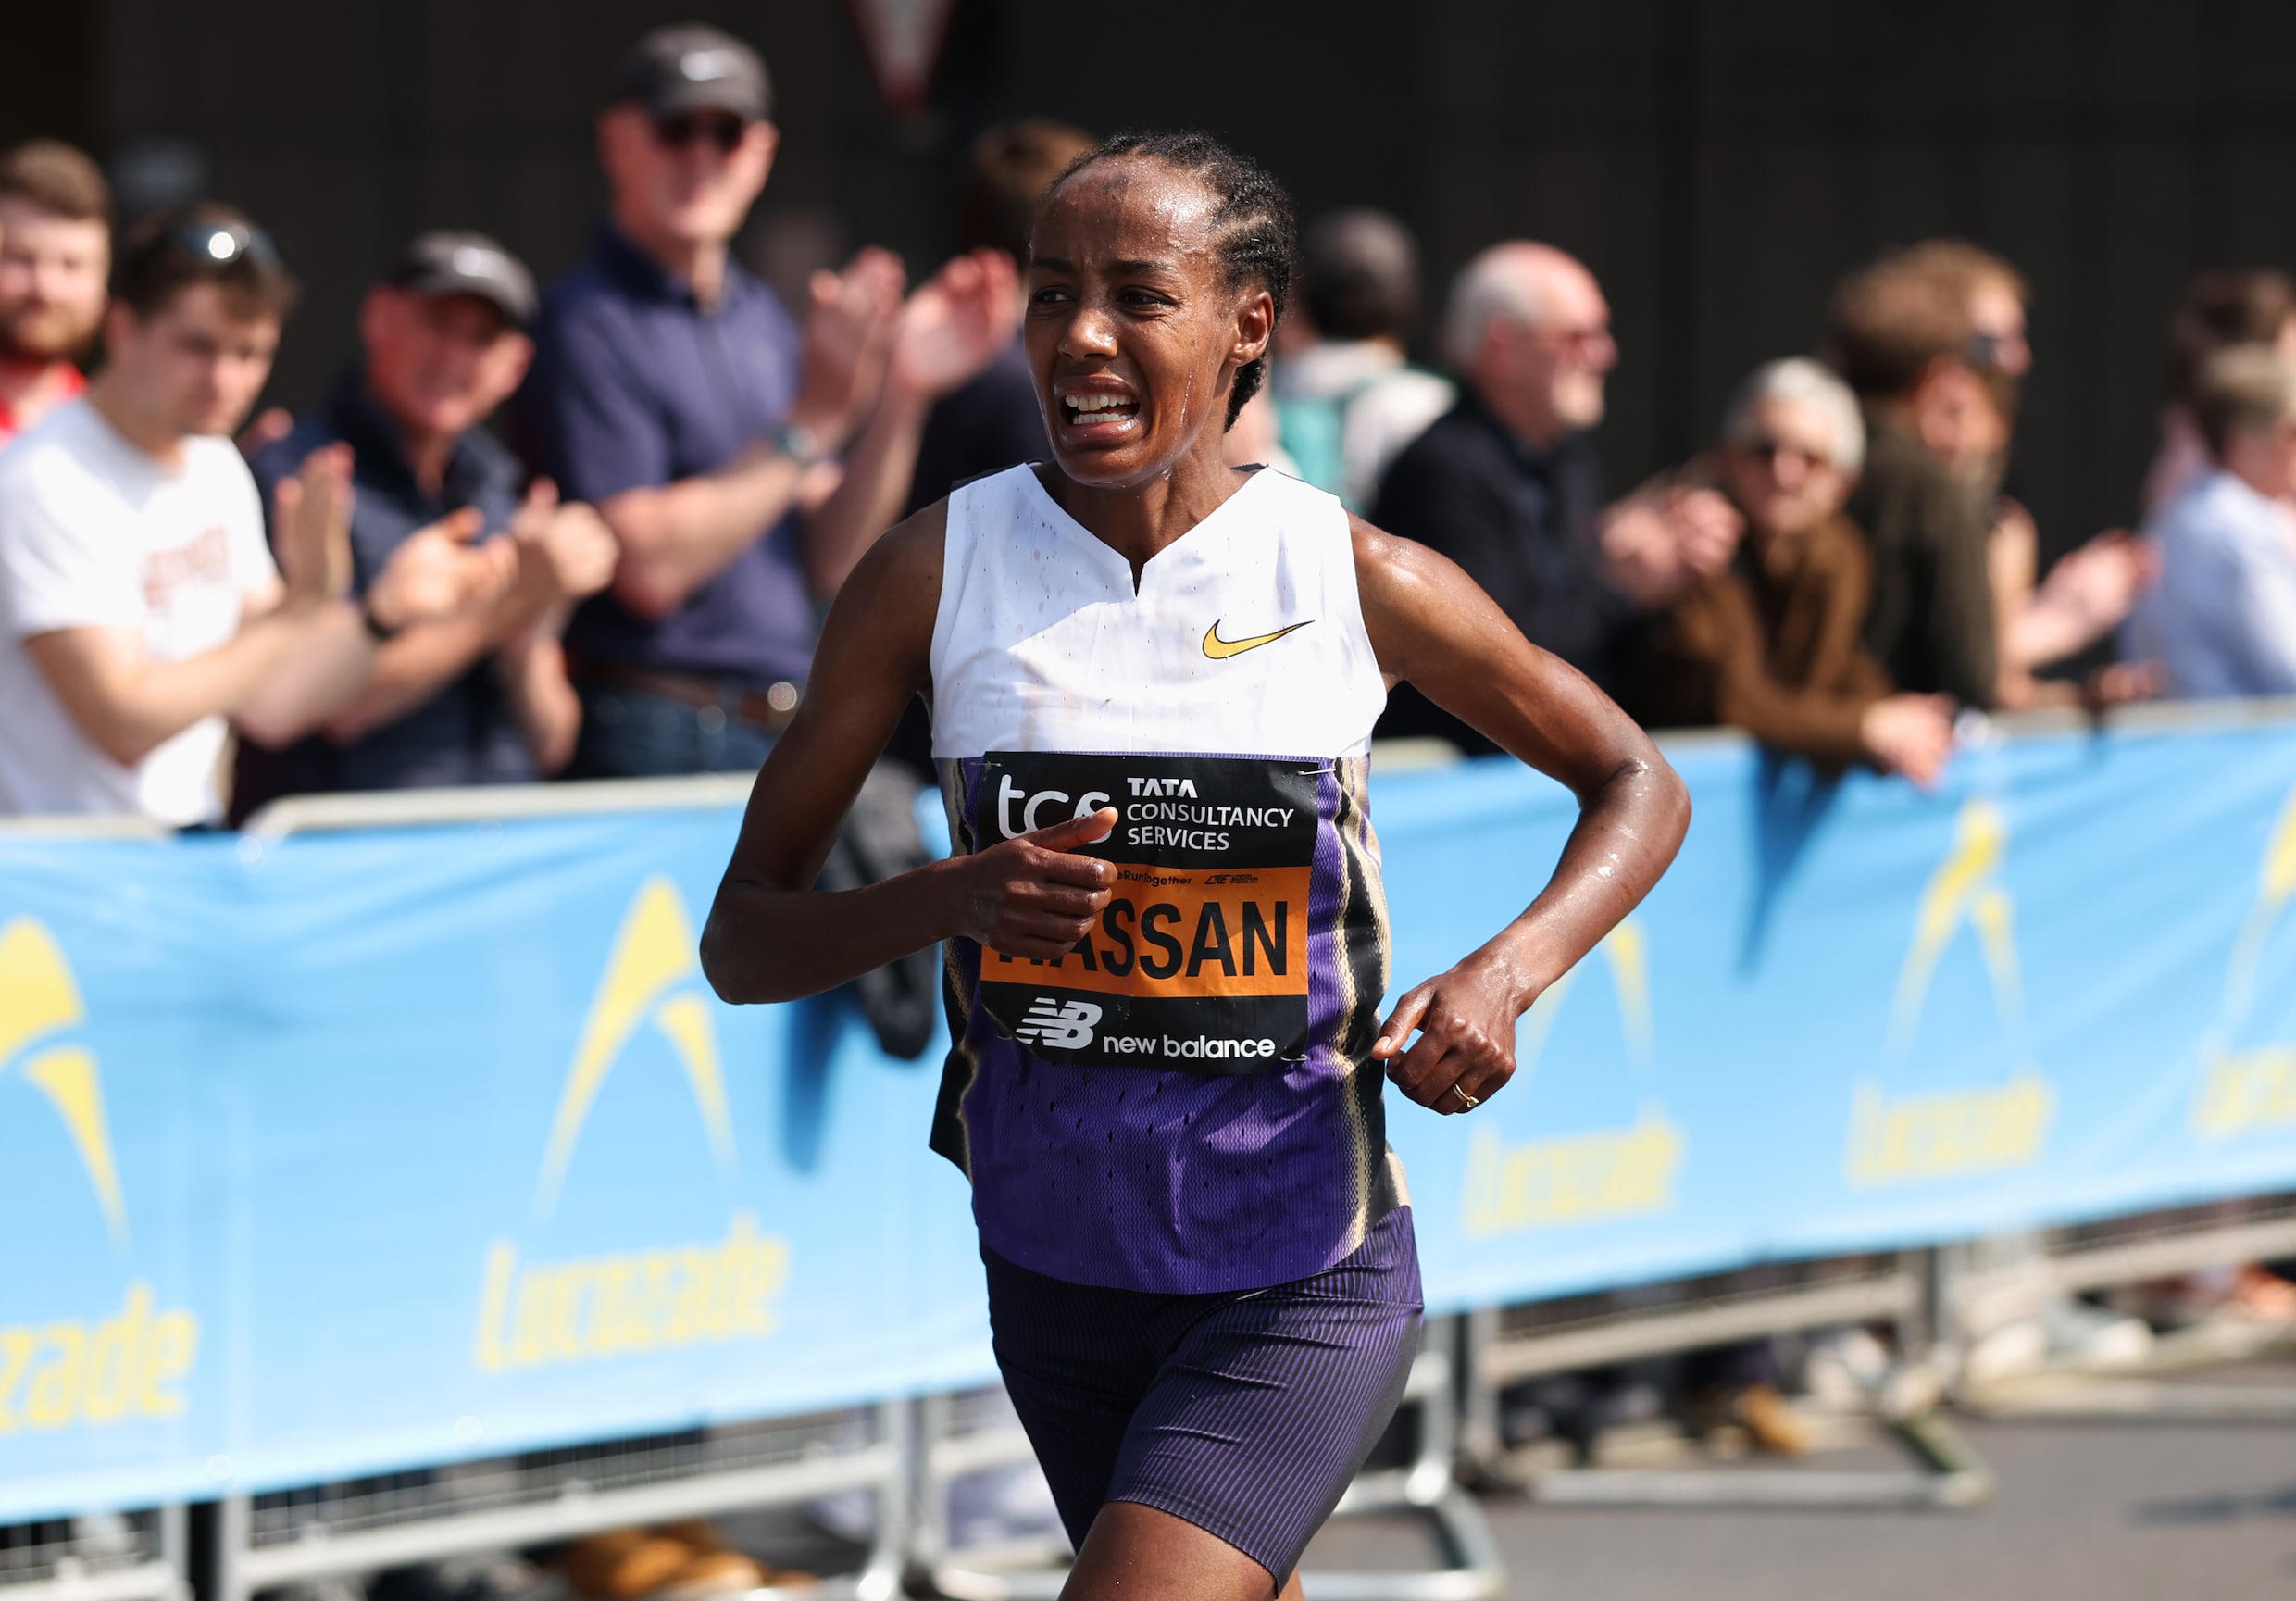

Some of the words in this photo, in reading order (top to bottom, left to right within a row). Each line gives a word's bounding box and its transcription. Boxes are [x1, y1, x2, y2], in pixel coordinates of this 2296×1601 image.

[1127, 777, 1198, 798] TATA
[1126, 803, 1294, 828] CONSULTANCY
[1127, 827, 1230, 851] SERVICES
[999, 898, 1288, 980] SSAN
[1104, 1034, 1156, 1054] new
[1163, 1034, 1276, 1059] balance
